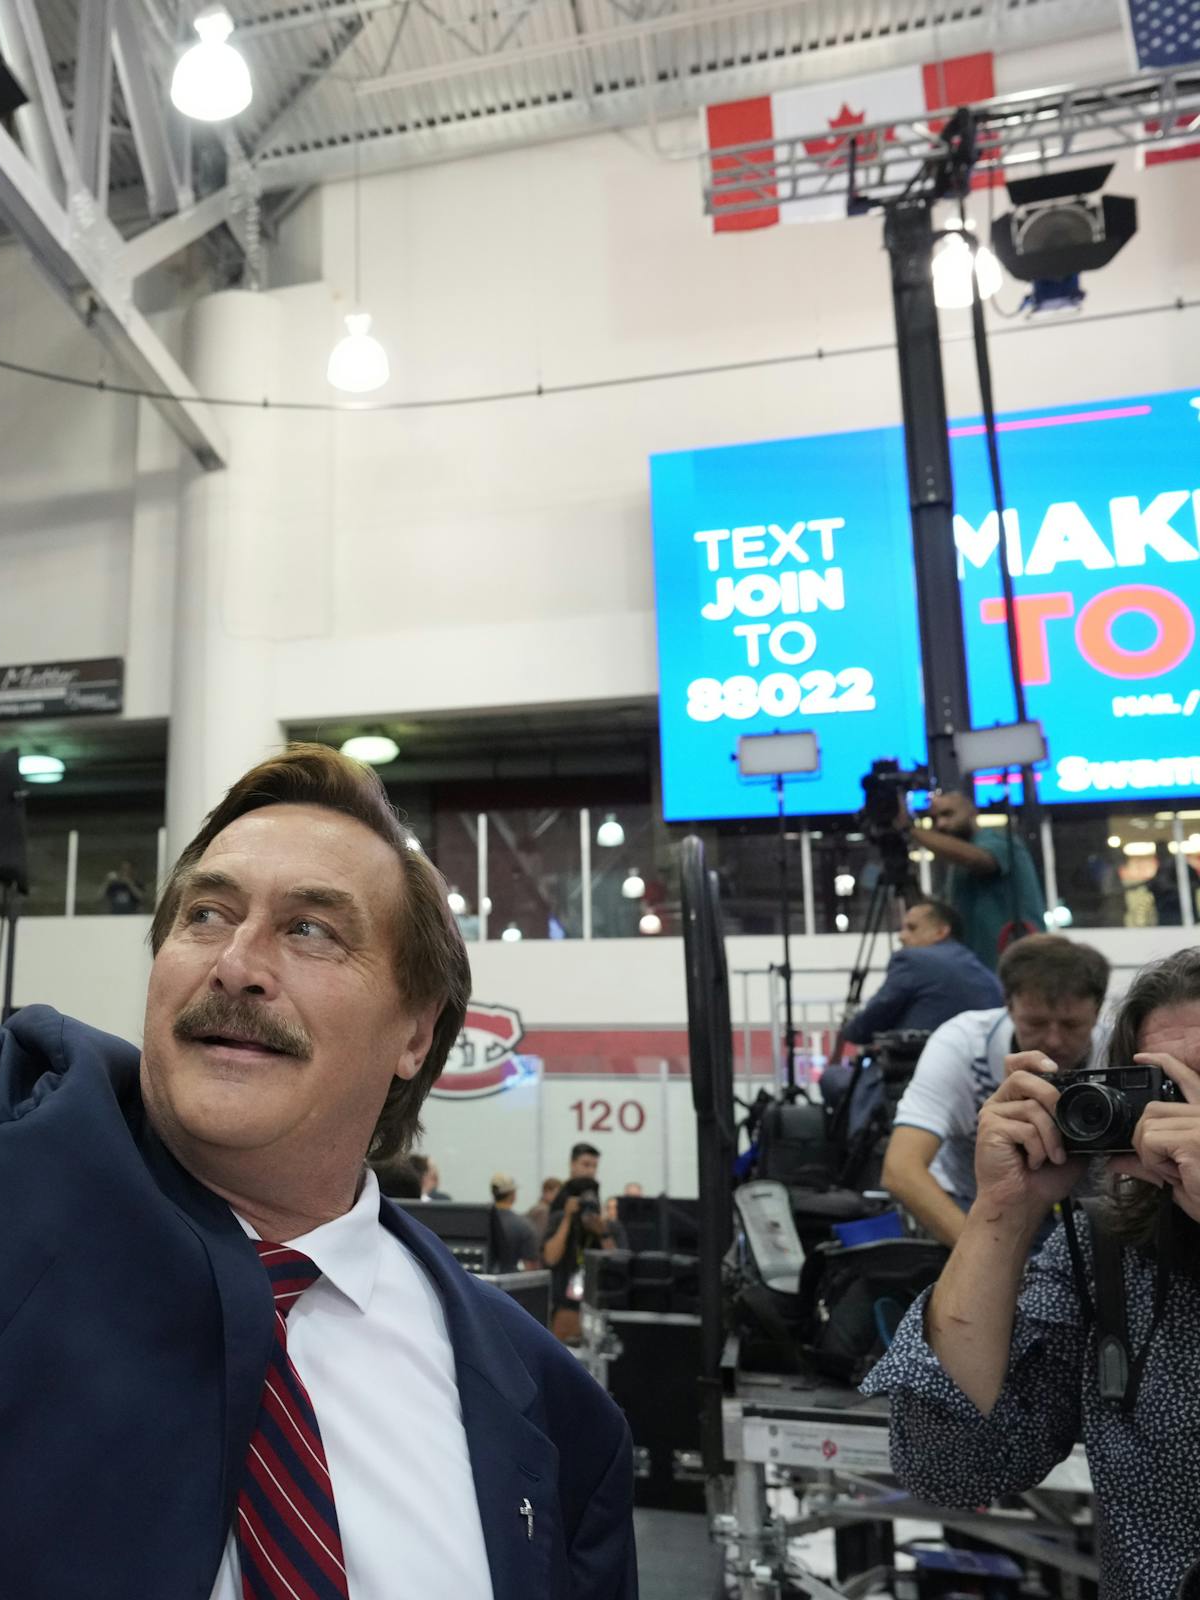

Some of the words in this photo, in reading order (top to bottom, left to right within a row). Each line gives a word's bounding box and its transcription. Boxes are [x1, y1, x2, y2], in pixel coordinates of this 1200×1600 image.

[694, 517, 845, 571] TEXT
[953, 489, 1200, 580] MAK
[701, 567, 845, 620] JOIN
[733, 620, 816, 667] TO
[979, 584, 1196, 685] TO
[687, 666, 876, 721] 88022
[569, 1099, 646, 1133] 120
